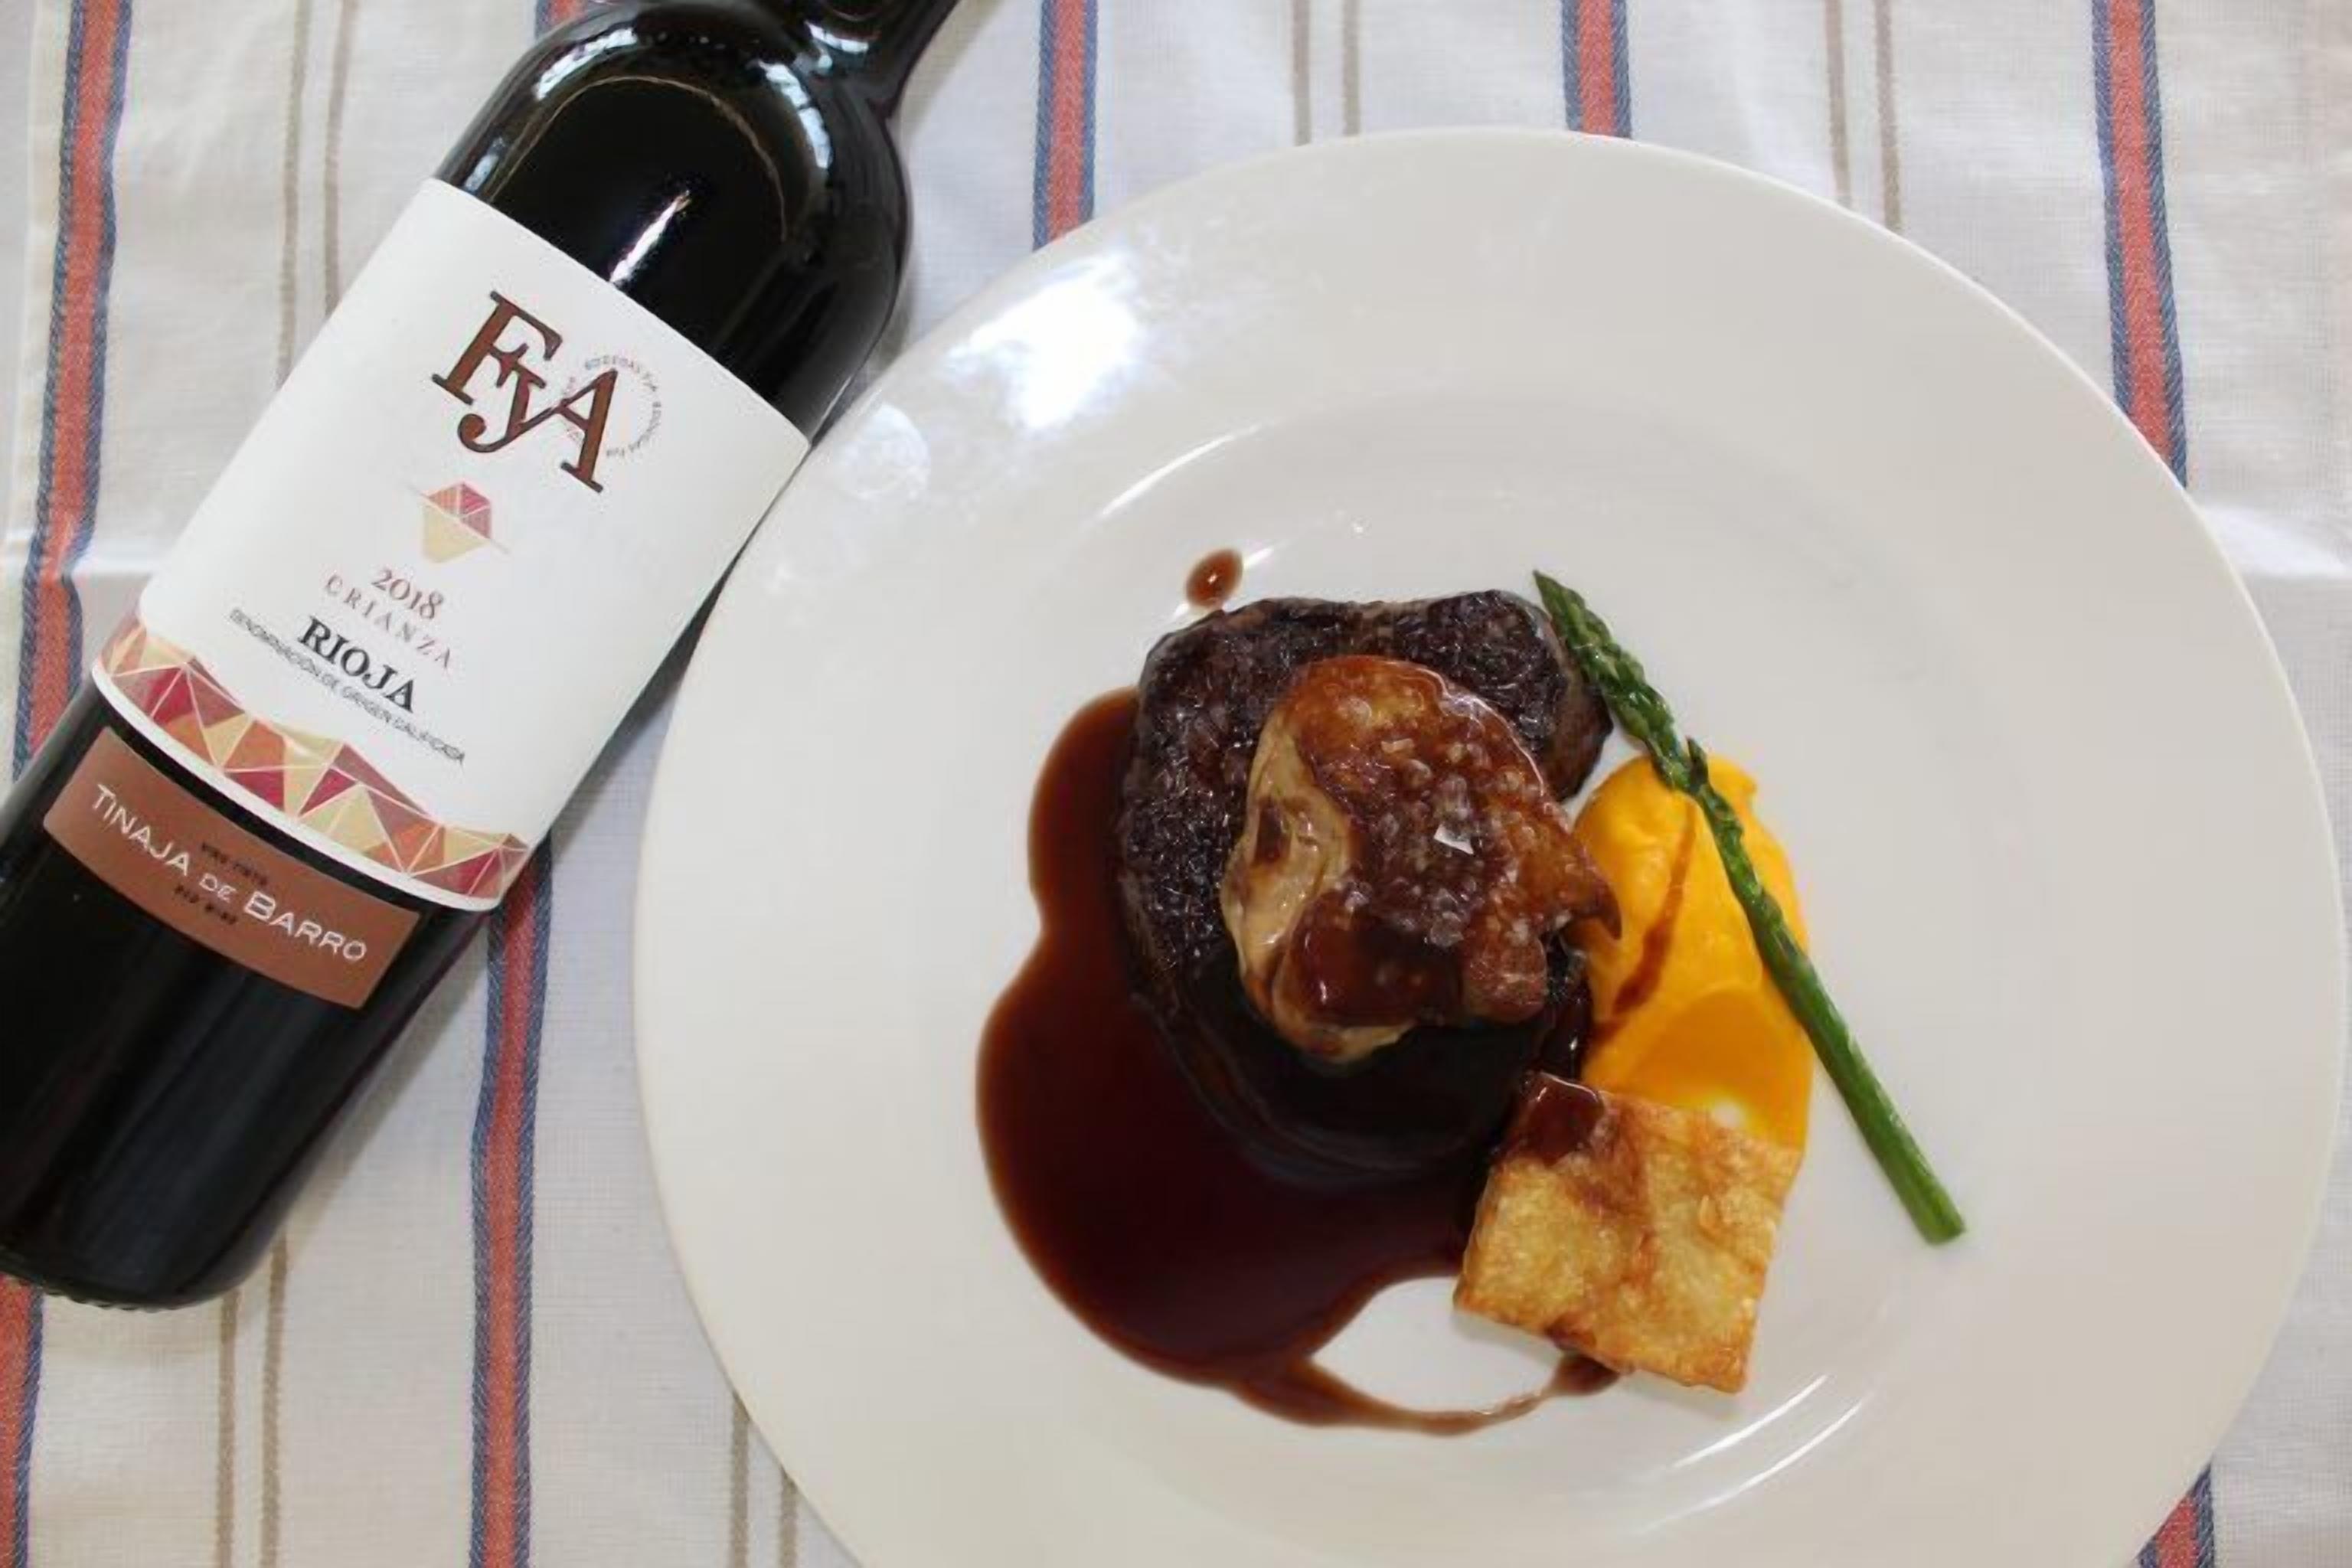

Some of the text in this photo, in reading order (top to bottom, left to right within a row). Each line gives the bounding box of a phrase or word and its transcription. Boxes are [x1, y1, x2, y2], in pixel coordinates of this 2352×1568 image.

[325, 574, 450, 668] CRIANZA
[371, 569, 443, 619] 2018
[297, 616, 413, 713] RIOJA
[90, 783, 191, 877] TINAJA
[198, 872, 237, 903] DE
[243, 890, 368, 962] BARRO
